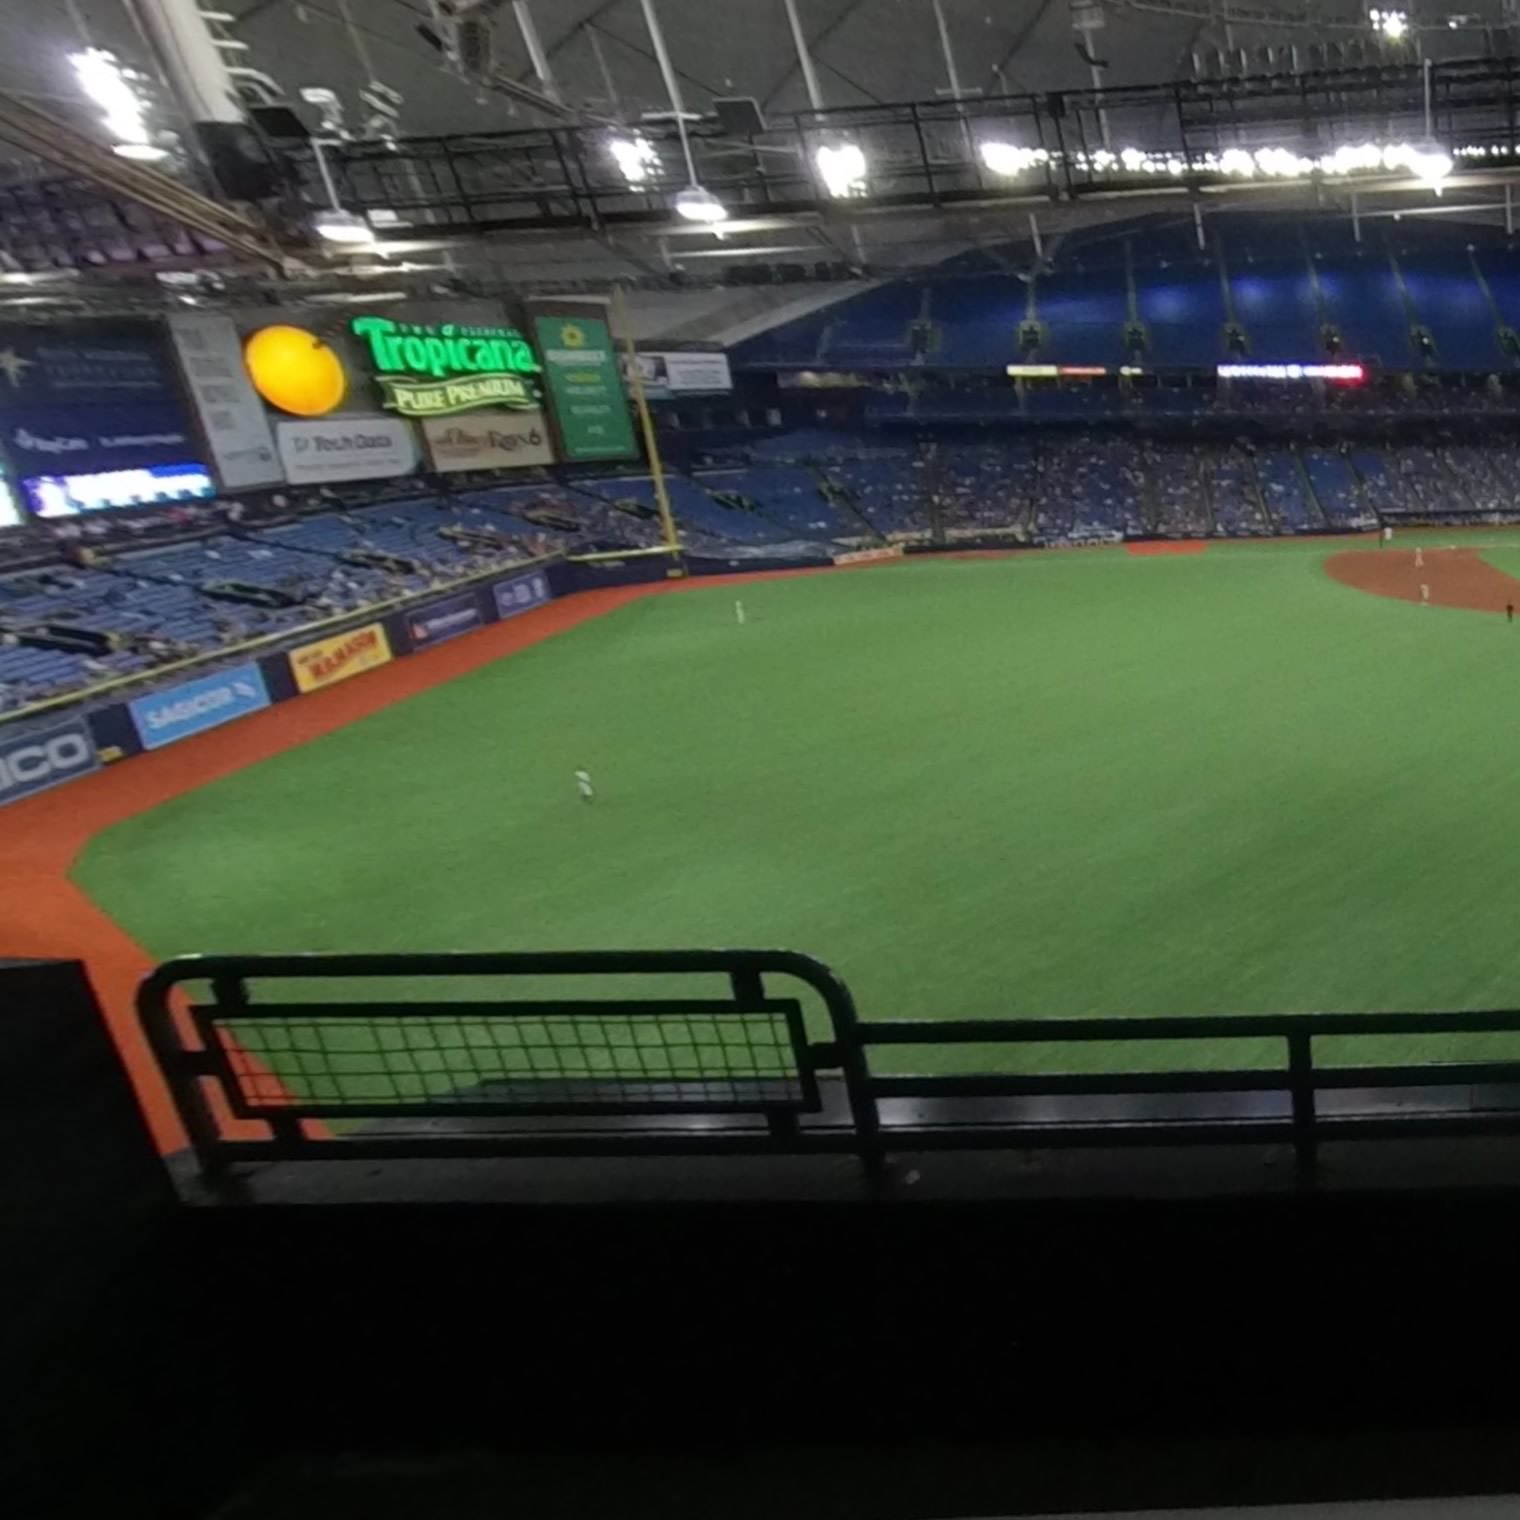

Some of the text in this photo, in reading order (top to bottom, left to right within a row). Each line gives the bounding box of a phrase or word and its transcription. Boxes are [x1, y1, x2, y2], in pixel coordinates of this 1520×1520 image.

[352, 316, 537, 377] Tropicana
[393, 379, 526, 410] PURE PREMIUM
[313, 433, 393, 452] Tech Data
